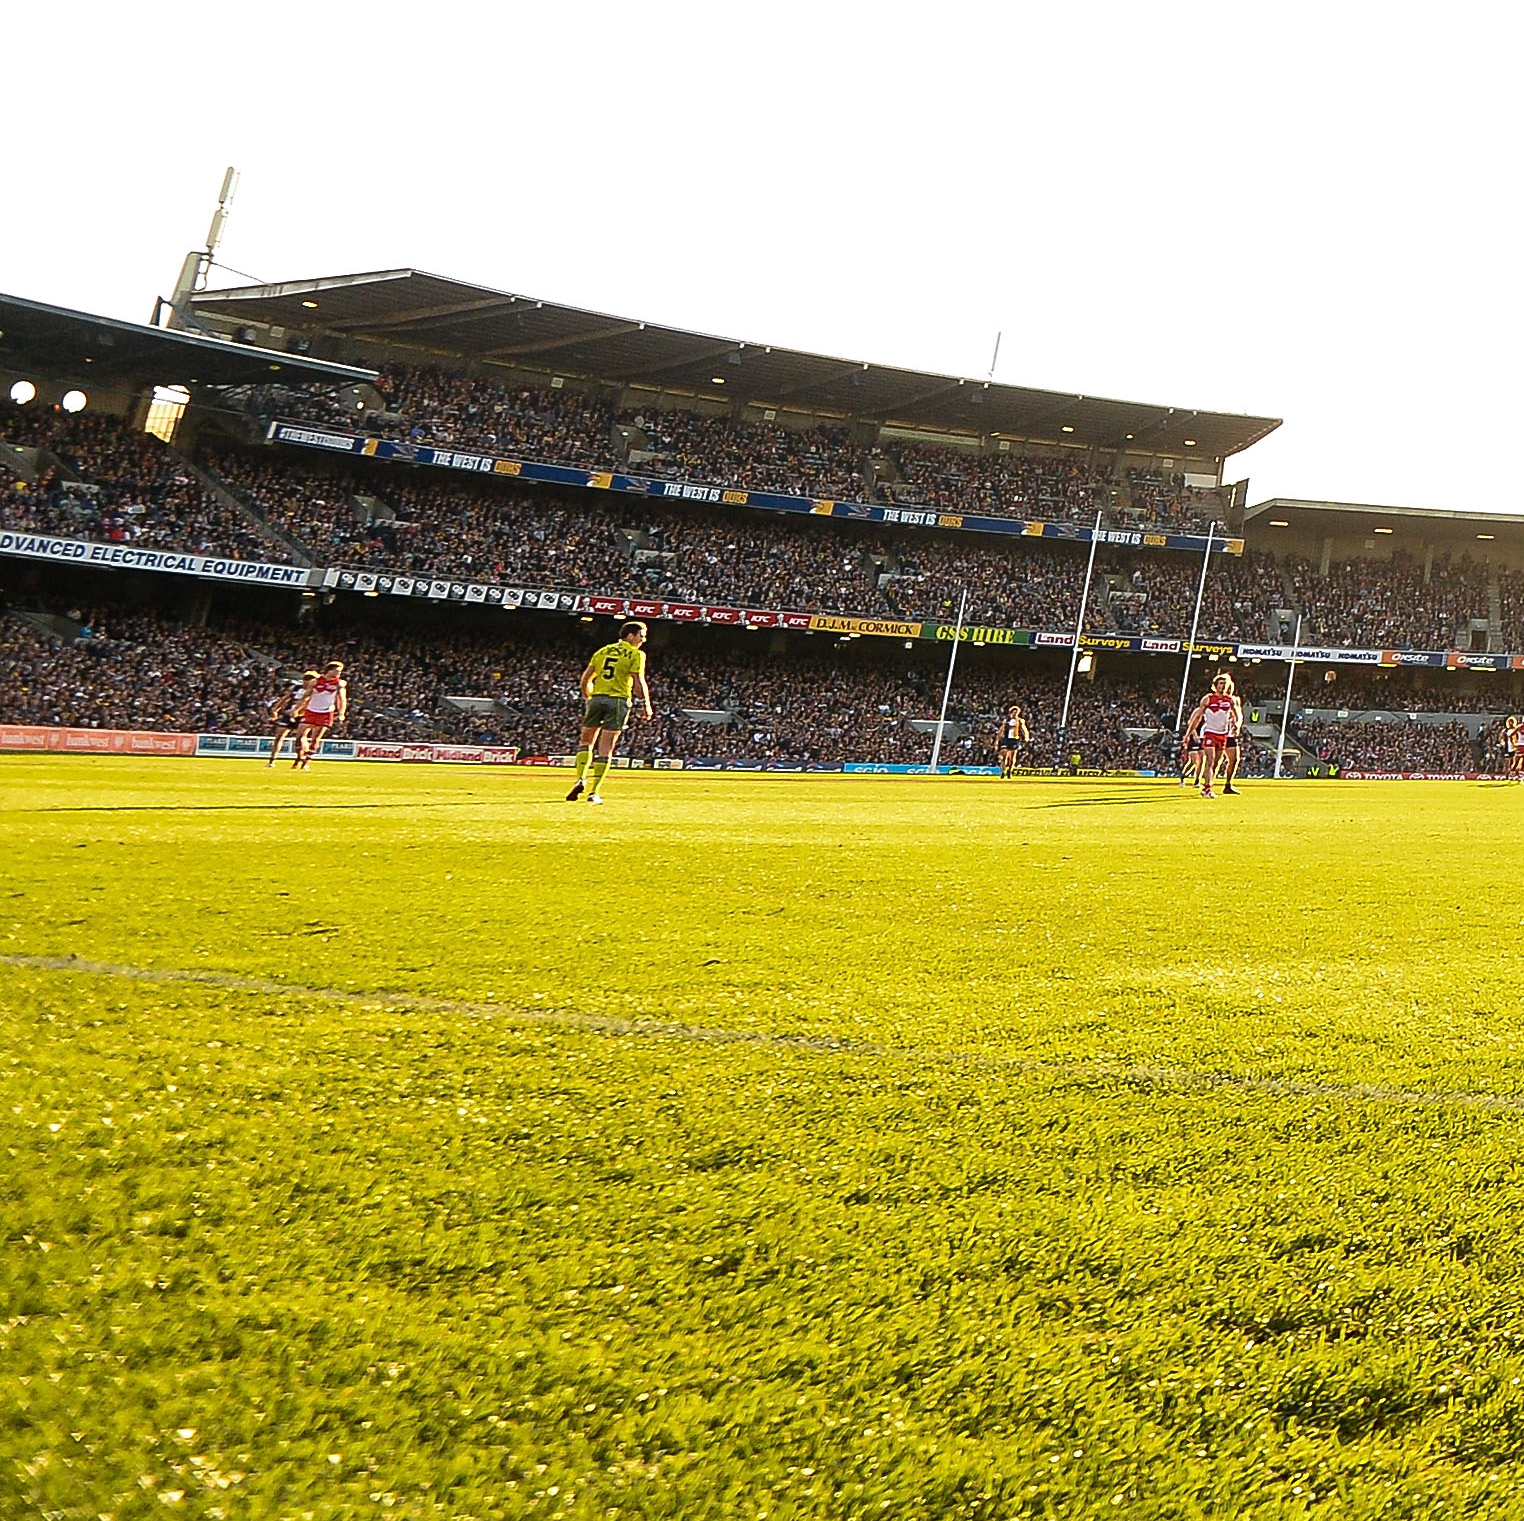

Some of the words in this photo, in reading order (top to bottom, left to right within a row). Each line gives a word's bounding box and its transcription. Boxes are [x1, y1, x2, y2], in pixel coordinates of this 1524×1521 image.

[431, 451, 452, 466] THE
[452, 453, 480, 470] WEST
[480, 458, 493, 472] IS
[663, 483, 681, 497] THE
[682, 485, 709, 501] WEST
[709, 489, 721, 502] IS
[883, 509, 899, 522] THE
[900, 511, 927, 525] WEST
[926, 515, 937, 526] IS
[1107, 532, 1131, 544] WEST
[1131, 533, 1142, 545] IS
[90, 546, 197, 571] ELECTRICAL
[201, 560, 305, 583] EQUIPMENT
[595, 601, 617, 611] KFC
[634, 604, 656, 614] KFC
[673, 607, 695, 618] KFC
[711, 610, 733, 620] KFC
[750, 613, 771, 623] KFC
[788, 616, 809, 626] KFC
[858, 621, 914, 635] CORMICK
[971, 627, 1015, 643] HIRE
[1036, 633, 1074, 645] Land
[1078, 635, 1131, 649] Surveys
[1142, 639, 1179, 651] Land
[602, 656, 619, 680] 5
[357, 746, 401, 759] Midland
[402, 746, 433, 761] Brick
[436, 749, 482, 761] Midland
[483, 748, 514, 763] Brick
[1364, 773, 1403, 781] TOYOTA
[1426, 773, 1466, 781] TOYOTA
